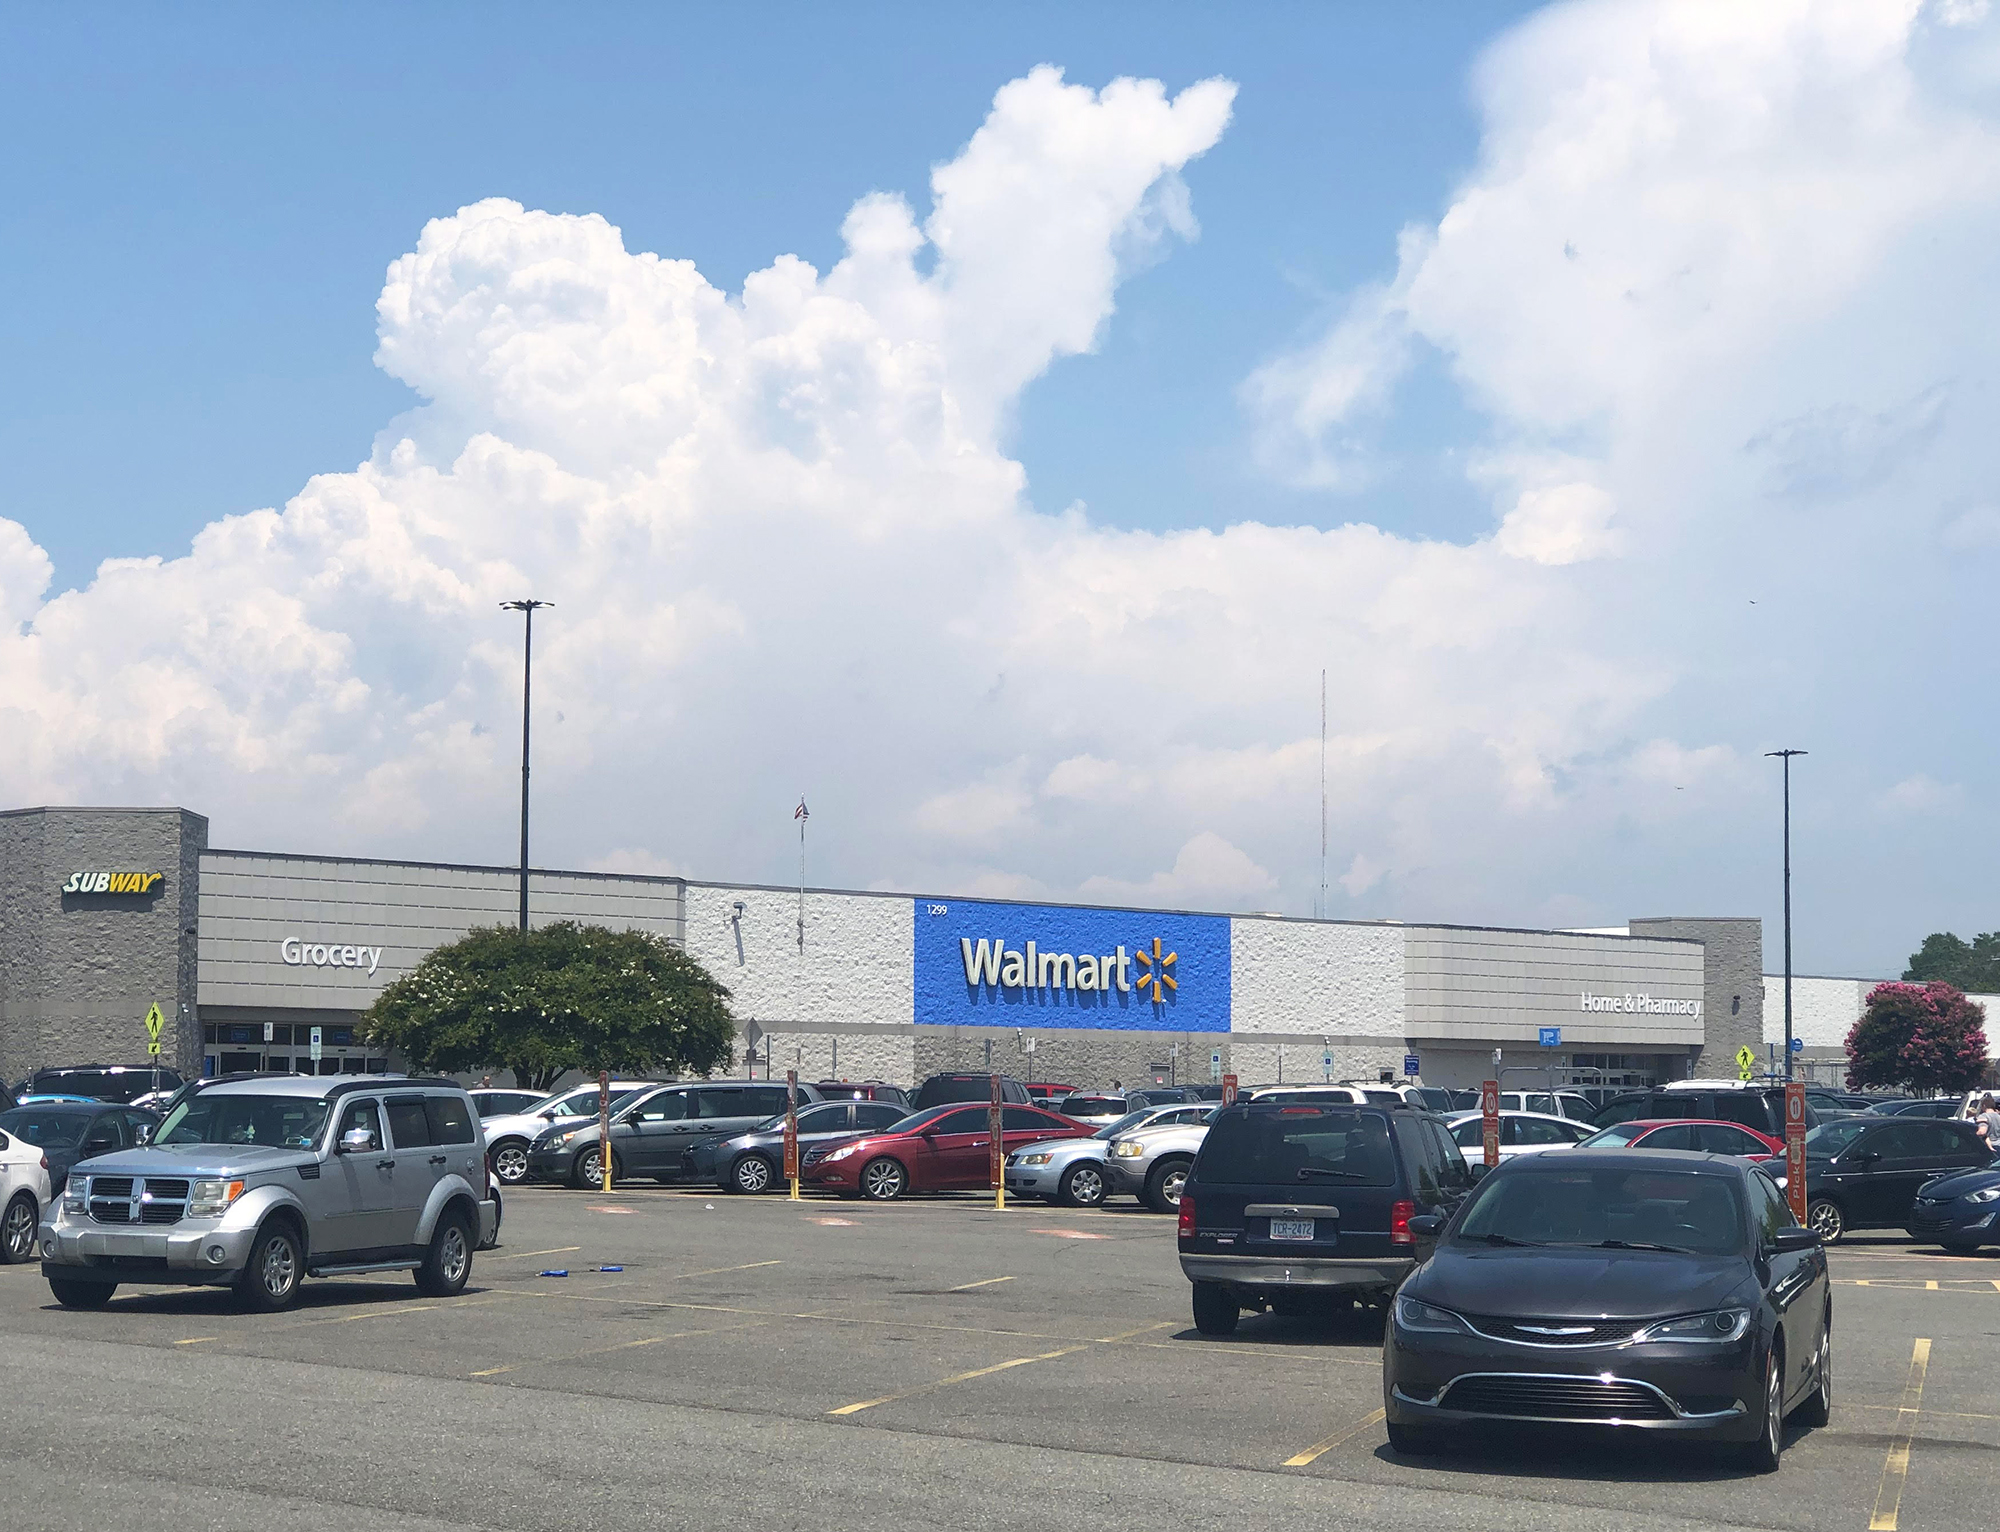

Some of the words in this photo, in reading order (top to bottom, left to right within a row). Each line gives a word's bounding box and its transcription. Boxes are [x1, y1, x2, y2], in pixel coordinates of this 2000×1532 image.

[62, 872, 162, 893] SUBWAY
[926, 904, 948, 915] 1299
[281, 936, 383, 975] Grocery
[961, 937, 1131, 992] Walmart
[1581, 991, 1622, 1013] Home
[1624, 993, 1635, 1013] &
[1637, 993, 1701, 1020] Pharmacy
[1273, 1222, 1312, 1235] TCR-2472
